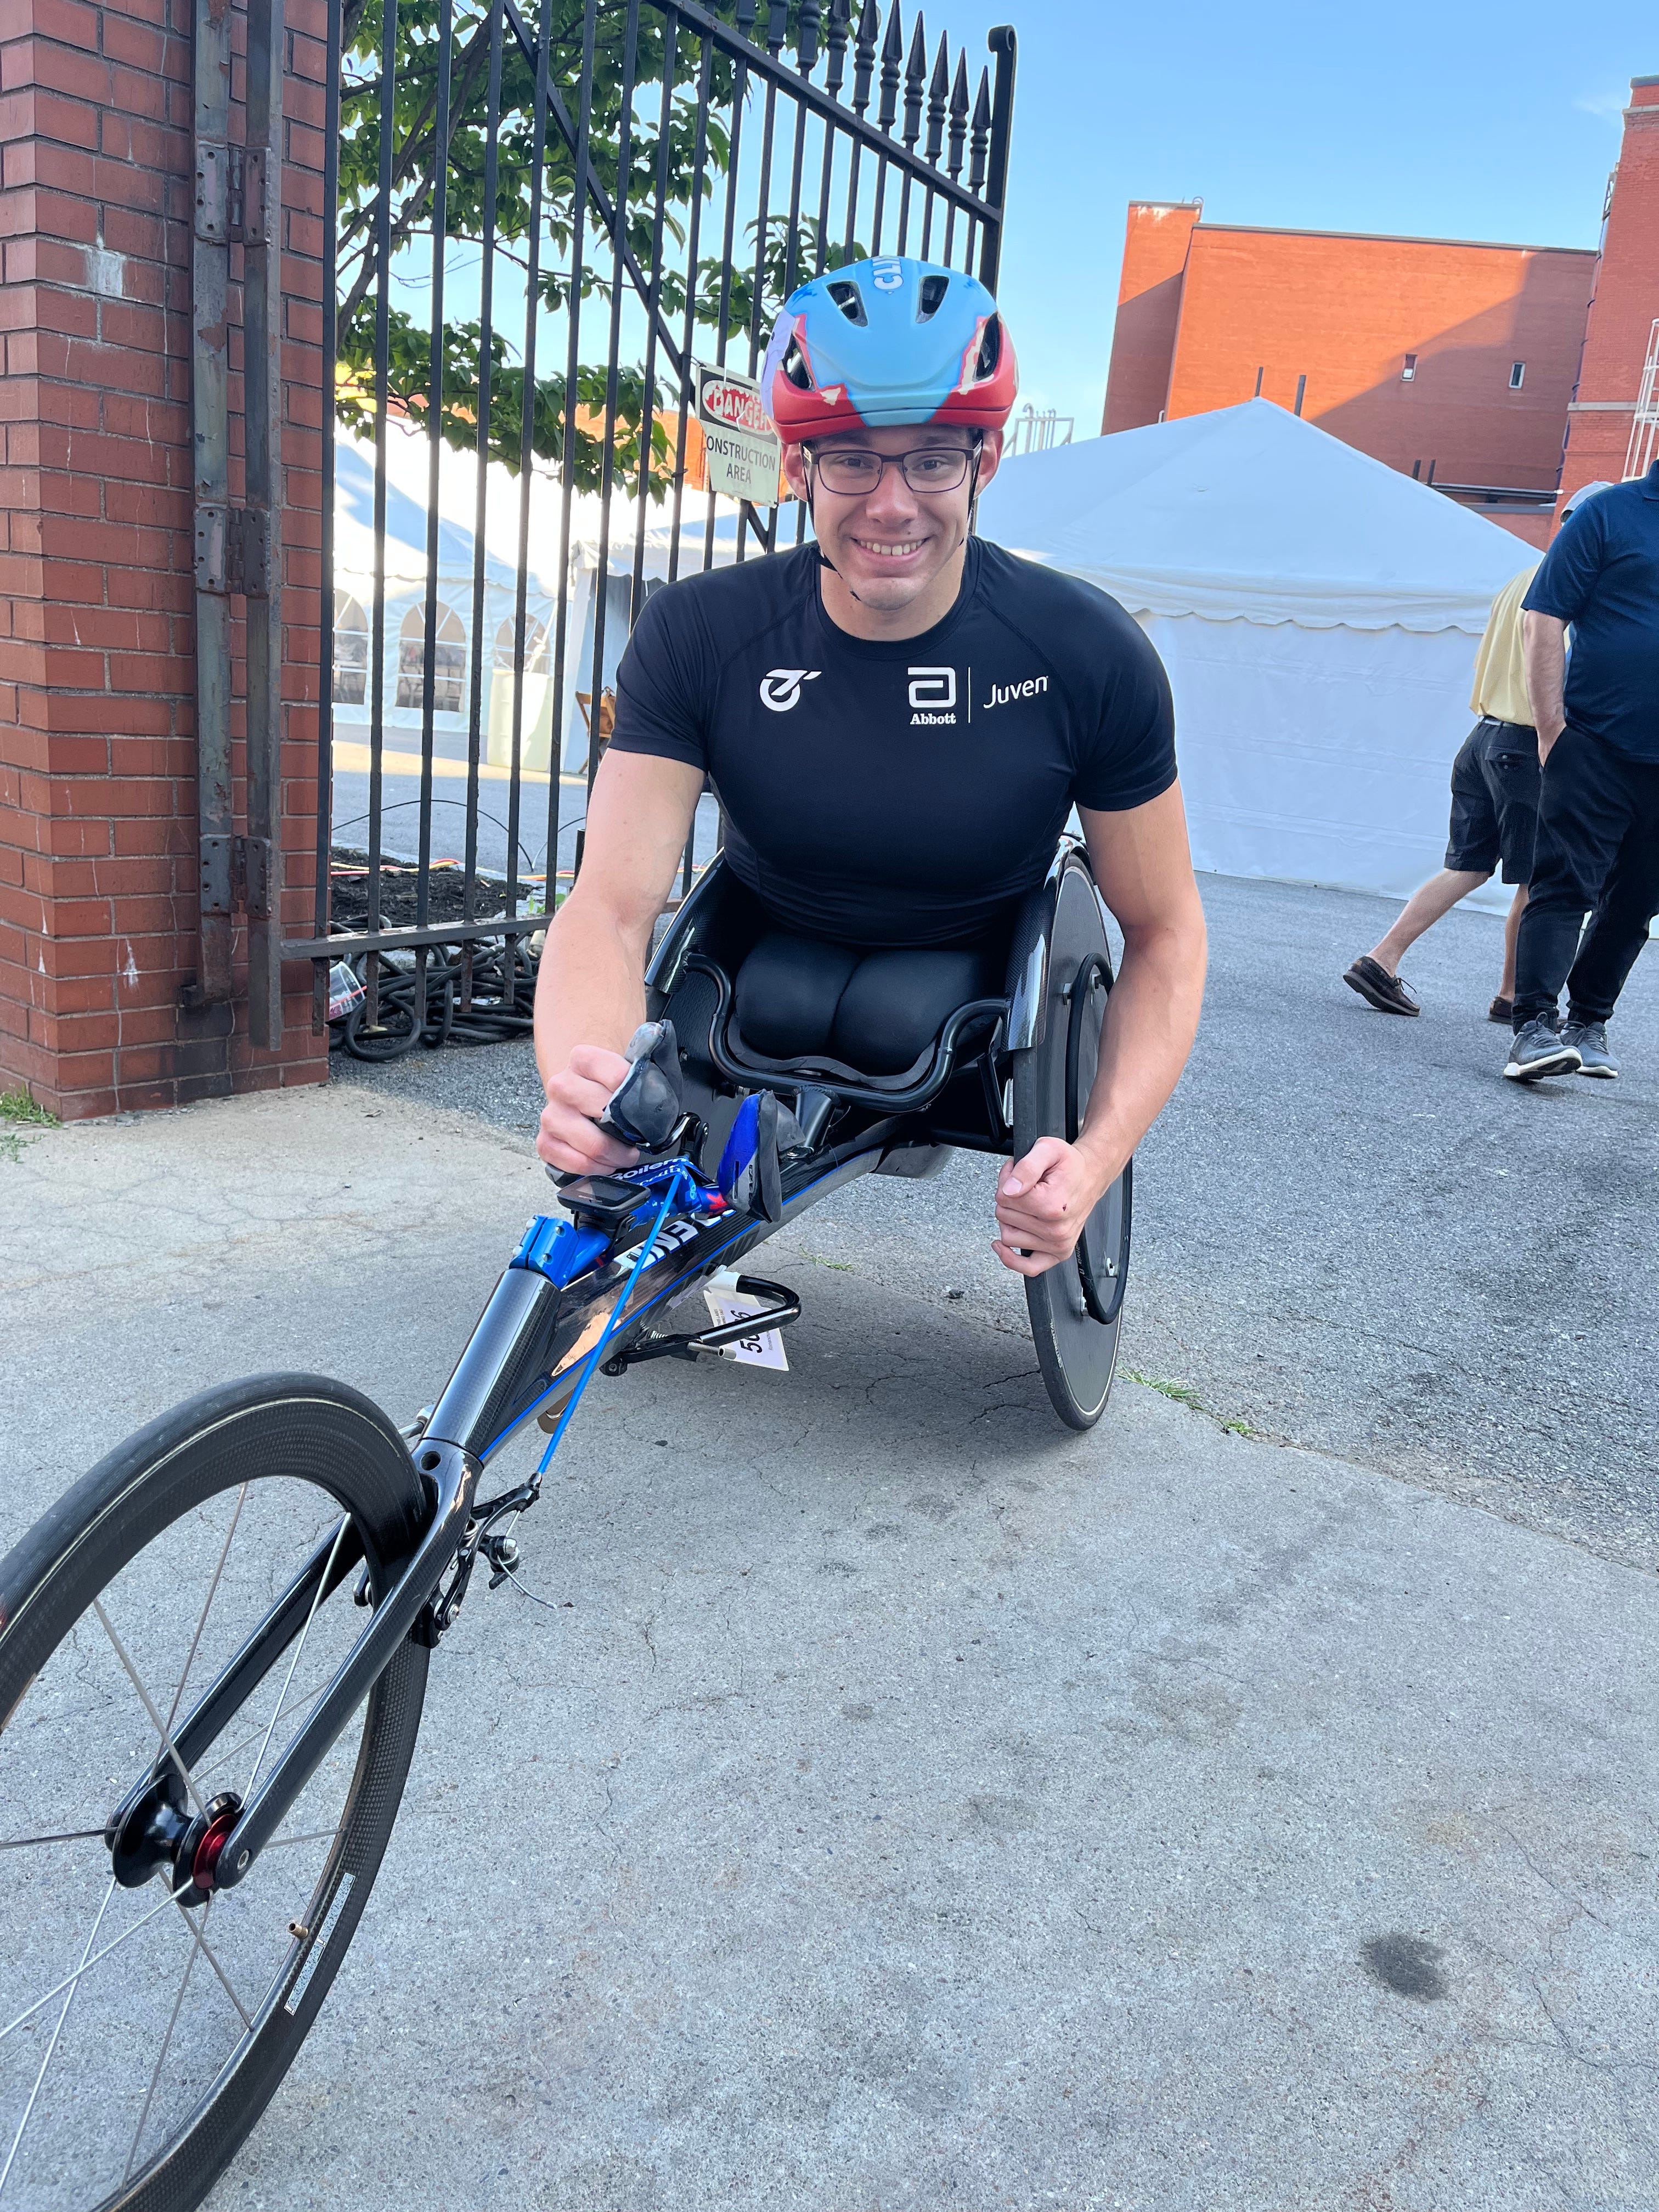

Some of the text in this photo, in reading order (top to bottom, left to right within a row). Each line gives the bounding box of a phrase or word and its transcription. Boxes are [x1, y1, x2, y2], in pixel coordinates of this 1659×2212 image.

[707, 435, 776, 471] ONSTRUCTION
[726, 463, 752, 484] AREA
[983, 676, 1047, 709] Juven
[910, 713, 956, 725] Abbott
